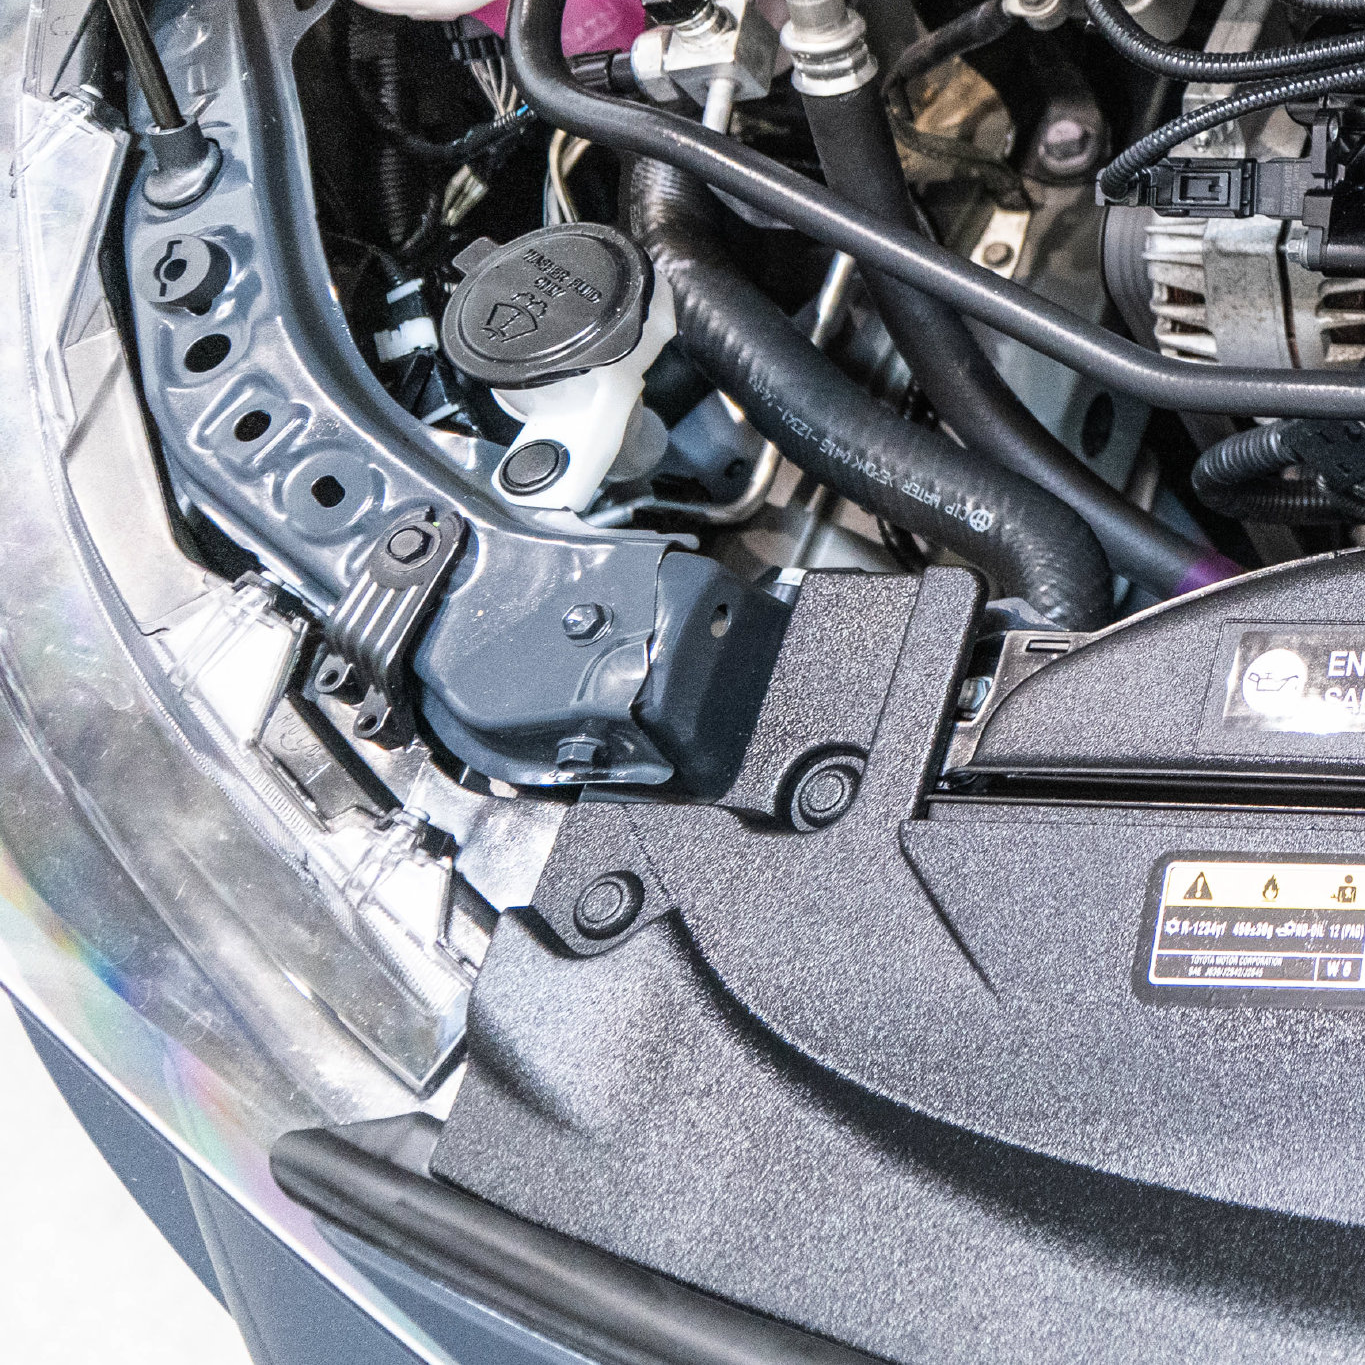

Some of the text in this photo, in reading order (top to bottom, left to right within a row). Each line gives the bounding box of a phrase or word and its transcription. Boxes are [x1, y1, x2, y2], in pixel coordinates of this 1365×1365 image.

[523, 248, 603, 303] WASHER FLUID
[534, 276, 566, 298] ONLY
[902, 479, 941, 510] WATER
[1191, 955, 1283, 966] TOYOTA MOTOR CORPORATION
